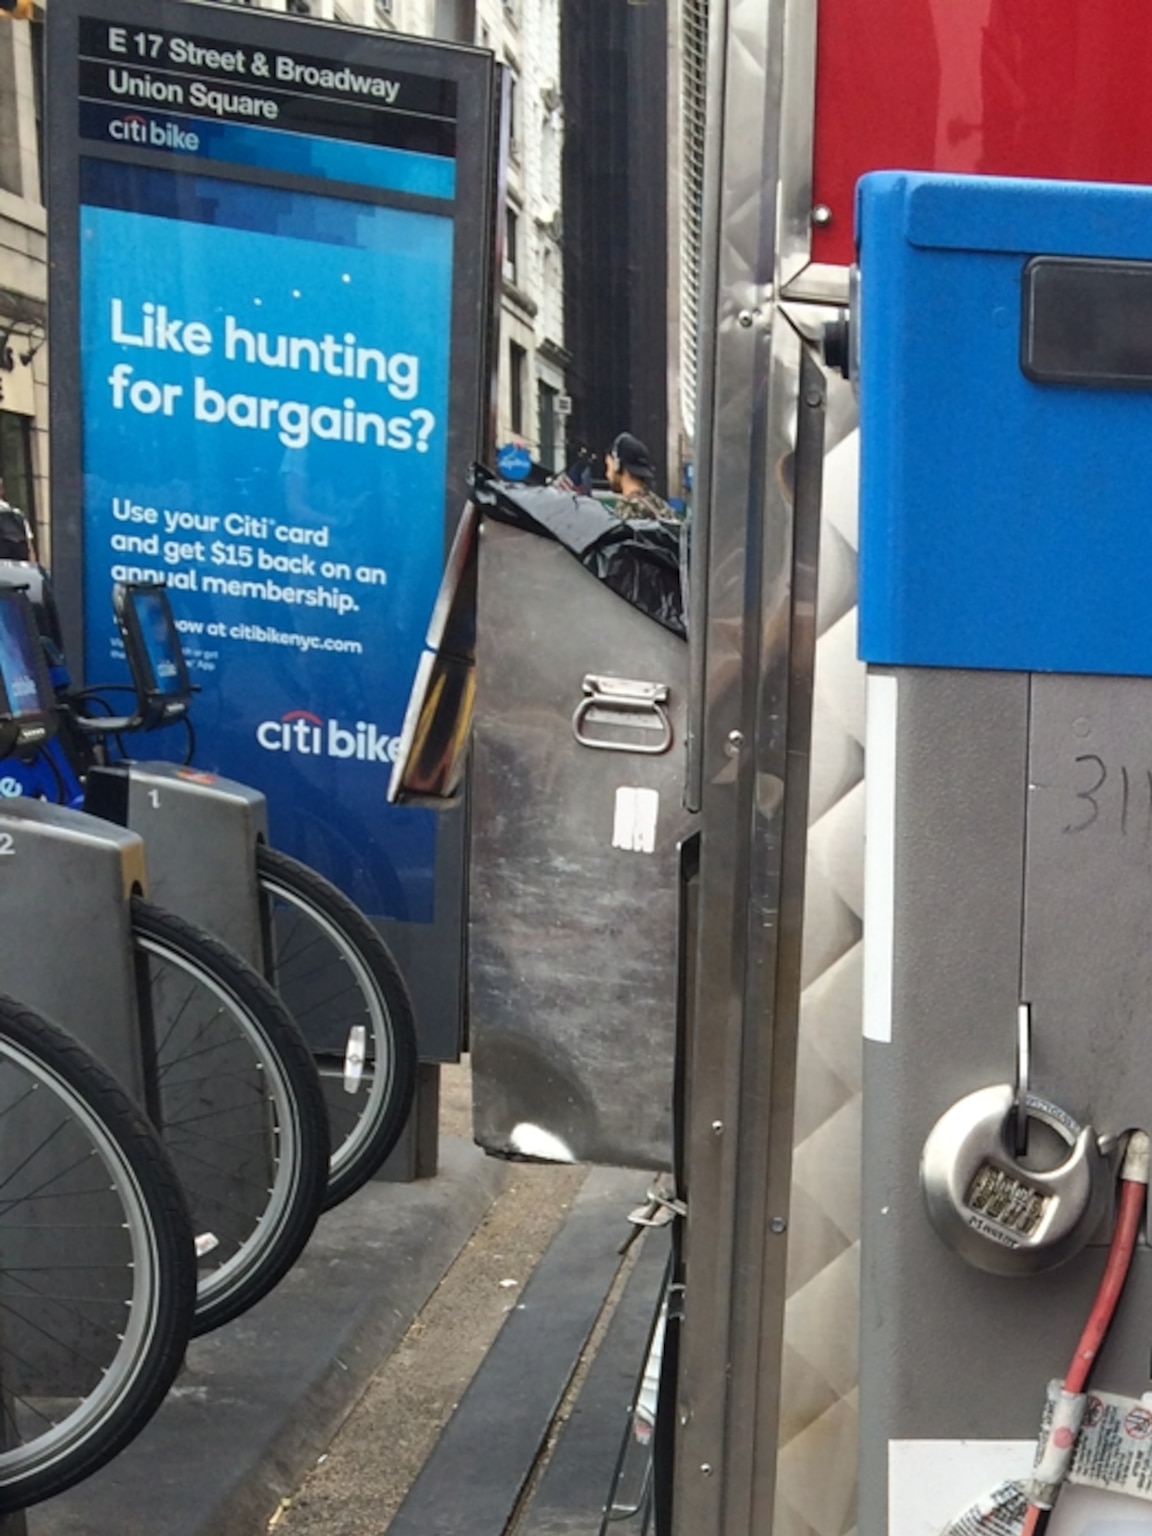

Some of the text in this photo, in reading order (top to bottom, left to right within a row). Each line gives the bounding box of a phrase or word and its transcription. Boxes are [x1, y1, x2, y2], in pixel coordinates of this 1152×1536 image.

[109, 27, 400, 103] E 17 Street & Broadway
[109, 69, 279, 120] Union Square
[109, 118, 199, 151] citi bike
[111, 298, 419, 400] Like hunting
[108, 362, 436, 453] for bargains?
[112, 497, 158, 524] Use
[164, 509, 220, 533] your
[275, 526, 329, 547] card
[111, 534, 387, 585] and get $15 back on an
[111, 565, 360, 615] annual membership.
[173, 619, 363, 654] ow at citibikenyc.com
[256, 718, 322, 755] citi
[148, 789, 160, 808] 1
